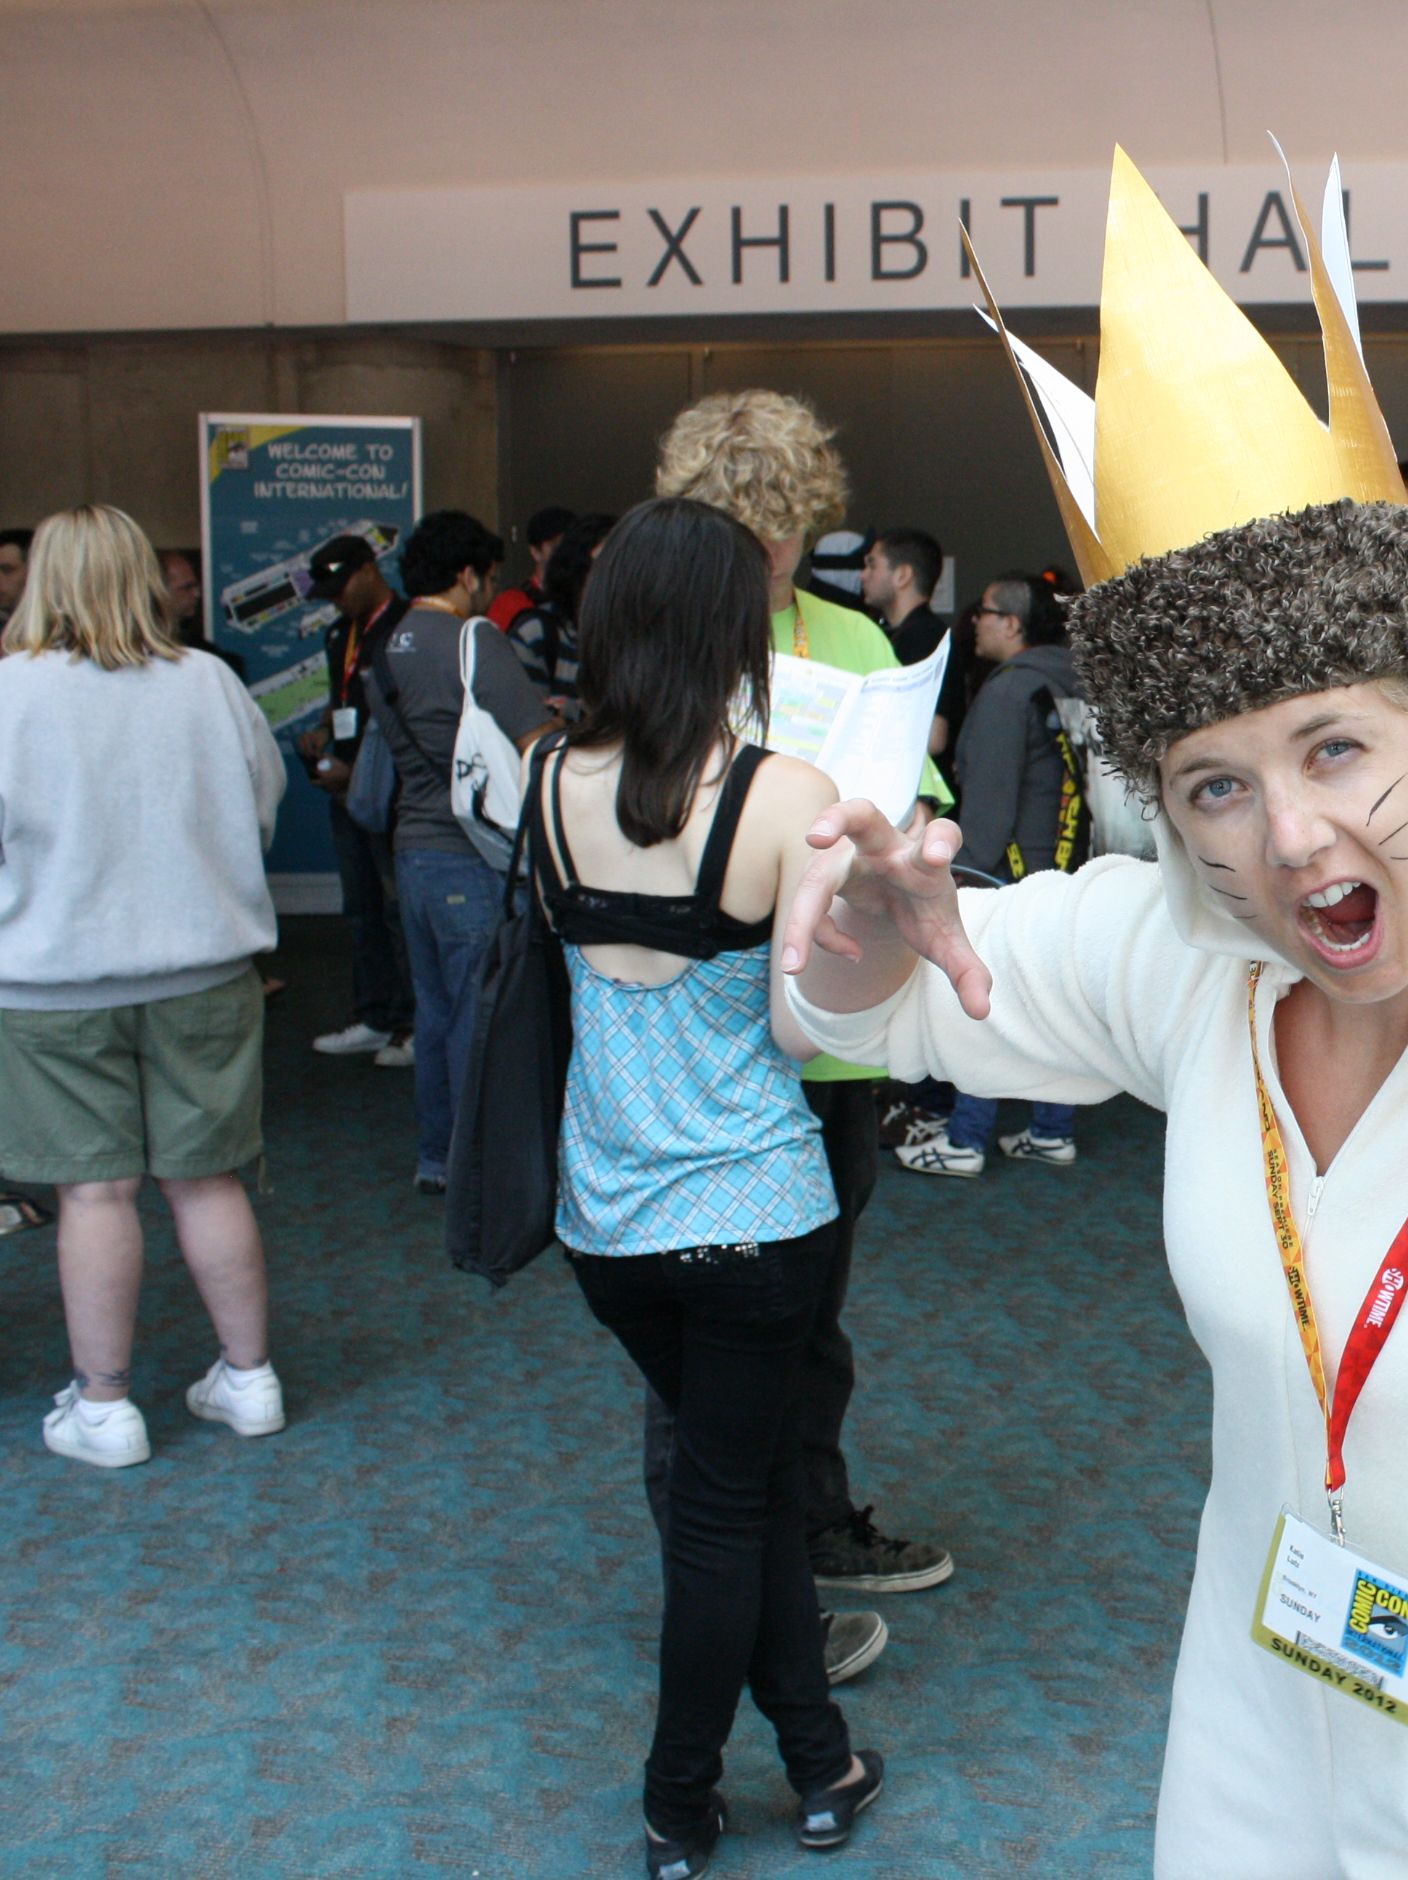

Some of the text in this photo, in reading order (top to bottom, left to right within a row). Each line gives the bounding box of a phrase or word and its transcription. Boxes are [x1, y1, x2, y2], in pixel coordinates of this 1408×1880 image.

[570, 195, 1060, 290] EXHIBIT
[267, 442, 394, 461] WELCOME TO
[275, 463, 386, 480] COMIC-CON
[254, 481, 408, 499] INTERNATIONAL!
[1267, 1150, 1289, 1250] SUNDAY SEPT 30
[1288, 1265, 1309, 1328] SHOWTIME
[1365, 1268, 1404, 1328] SHOWTIME
[1279, 1593, 1321, 1623] SUNDAY
[1349, 1580, 1377, 1634] COMIC
[1271, 1637, 1398, 1714] SUNDAY 2012
